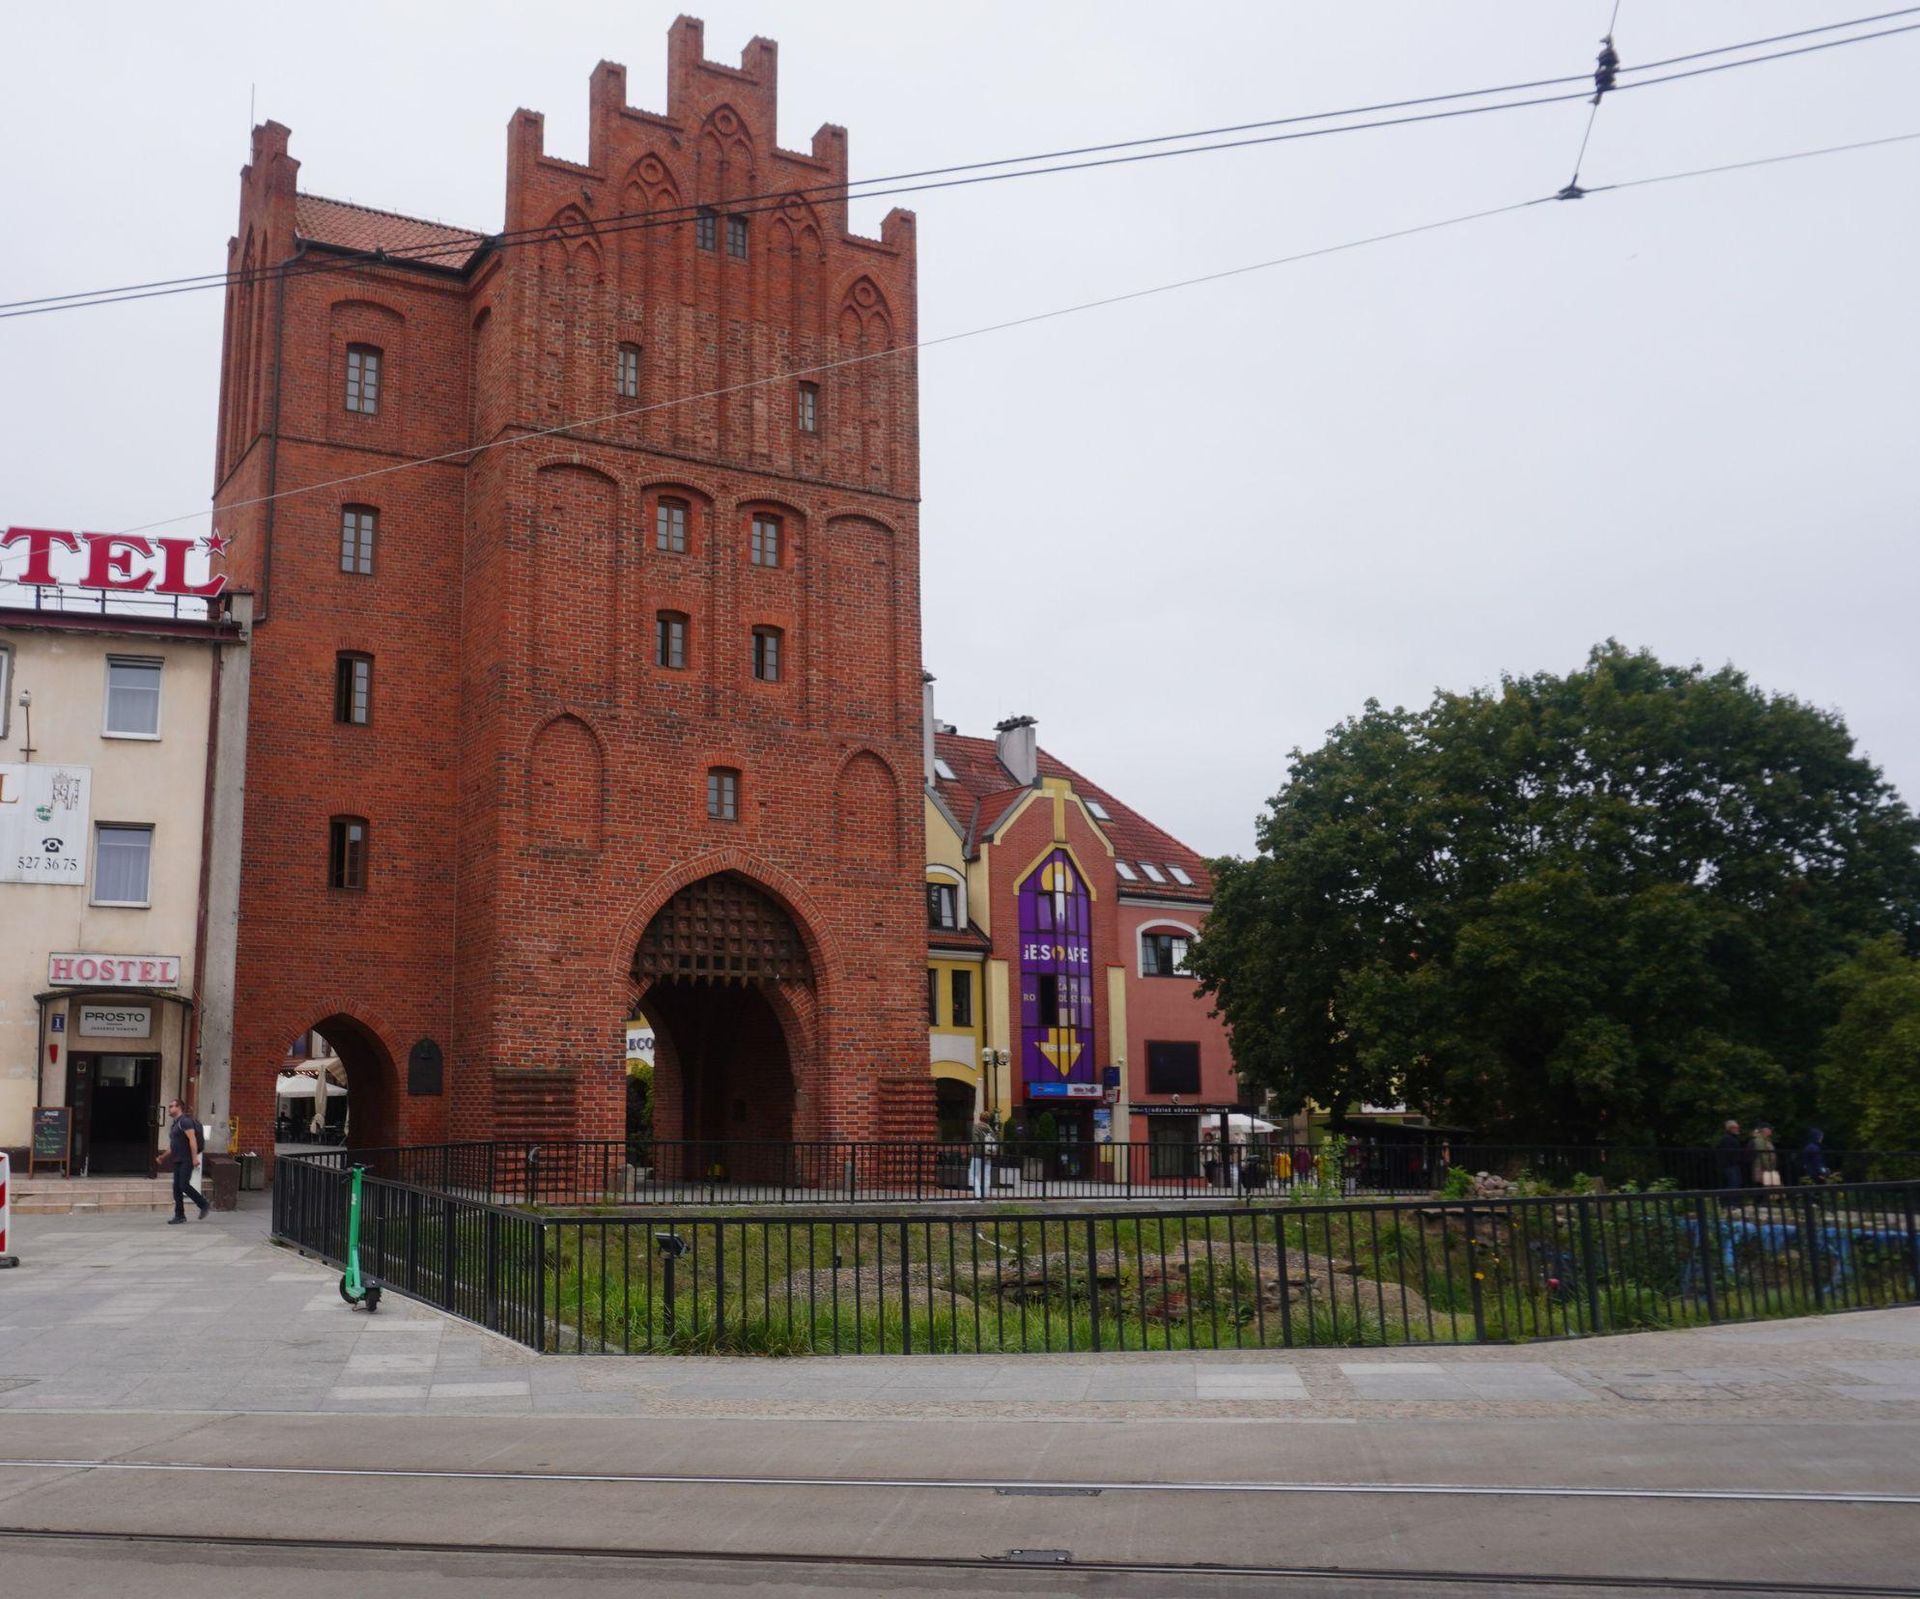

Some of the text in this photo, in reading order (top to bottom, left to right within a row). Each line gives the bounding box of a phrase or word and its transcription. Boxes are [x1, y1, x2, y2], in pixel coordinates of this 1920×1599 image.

[0, 525, 228, 597] TEL
[17, 856, 78, 871] 527 36 75
[51, 957, 177, 983] HOSTEL
[55, 1018, 61, 1027] 1
[85, 1012, 145, 1022] PROSTO
